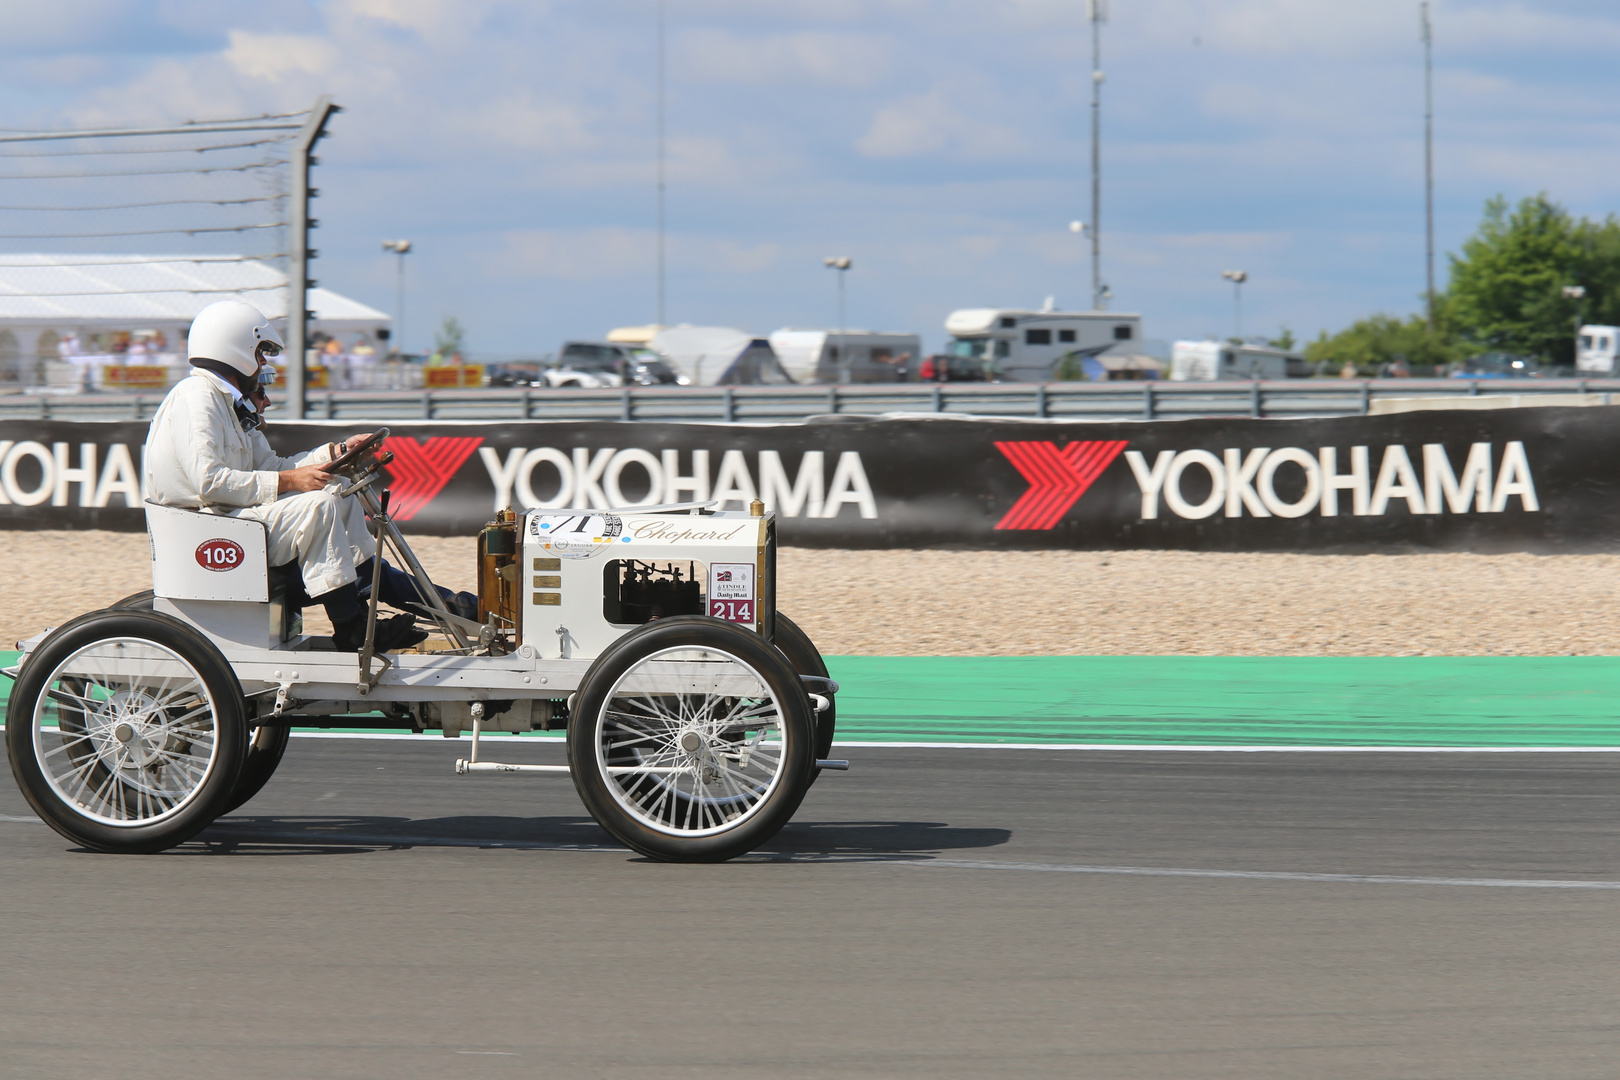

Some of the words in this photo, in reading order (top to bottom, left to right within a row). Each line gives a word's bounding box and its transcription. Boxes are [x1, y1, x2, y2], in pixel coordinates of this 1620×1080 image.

[0, 440, 145, 507] OHA
[478, 446, 878, 519] YOKOHAMA
[1125, 440, 1540, 520] YOKOHAMA
[627, 520, 746, 544] Chopard
[203, 547, 237, 564] 103
[713, 601, 751, 621] 214
